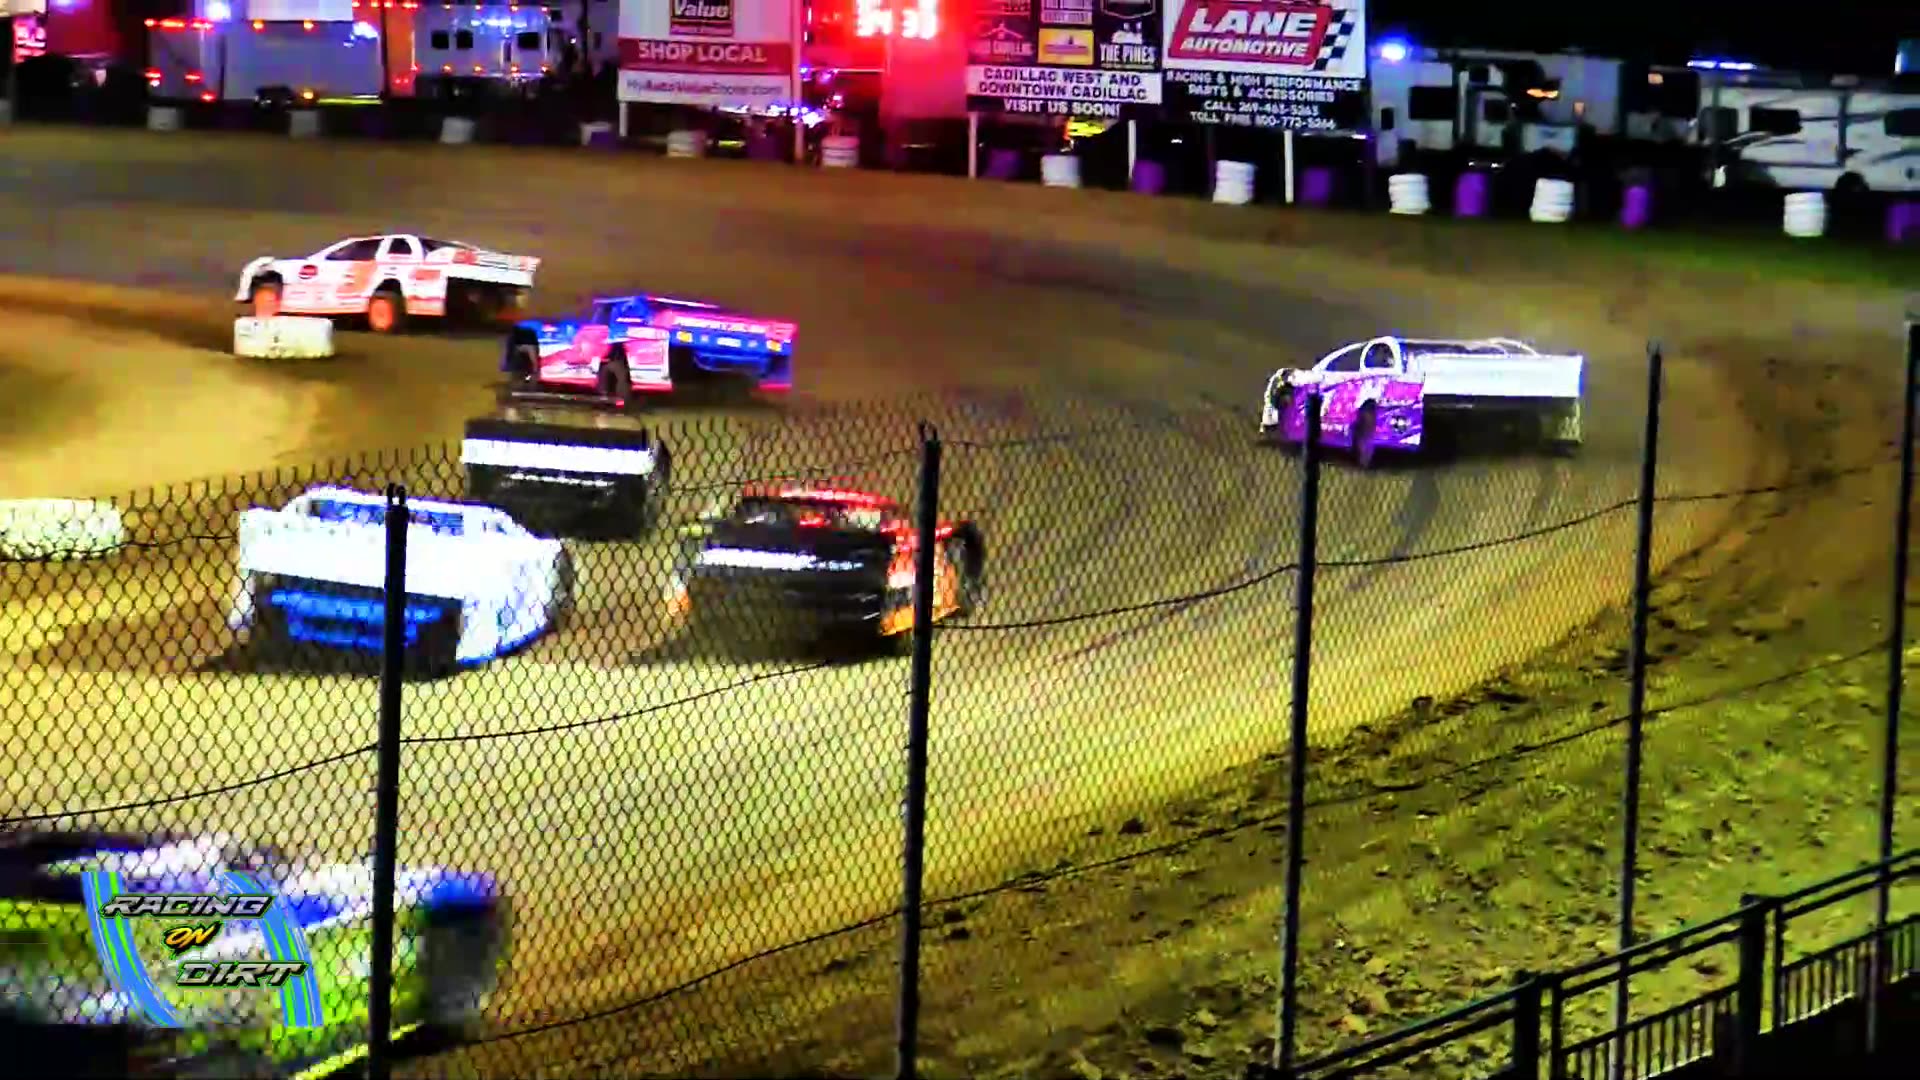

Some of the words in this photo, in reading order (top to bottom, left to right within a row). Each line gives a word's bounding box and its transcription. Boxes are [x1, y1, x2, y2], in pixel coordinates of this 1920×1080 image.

[1188, 8, 1318, 37] LANE
[638, 41, 693, 61] SHOP
[697, 43, 768, 63] LOCAL
[1101, 43, 1121, 62] THE
[1123, 44, 1156, 64] PINES
[1180, 37, 1309, 57] AUTOMOTIVE
[984, 67, 1057, 82] CADILLAC
[1063, 71, 1103, 84] WEST
[1109, 74, 1141, 86] AND
[1166, 71, 1212, 83] RACING
[1216, 73, 1226, 84] &
[1231, 75, 1260, 87] HIGH
[1265, 76, 1361, 91] PERFORMANCE
[979, 81, 1067, 96] DOWNTOWN
[1071, 85, 1147, 100] CADILLAC
[1188, 85, 1228, 97] PARTS
[1233, 87, 1242, 98] &
[1247, 89, 1335, 102] ACCESSORIES
[1003, 99, 1043, 112] VISIT
[1048, 101, 1068, 113] US
[1072, 102, 1121, 117] SOON!
[1204, 101, 1235, 112] CALL
[1190, 111, 1220, 123] TOLL
